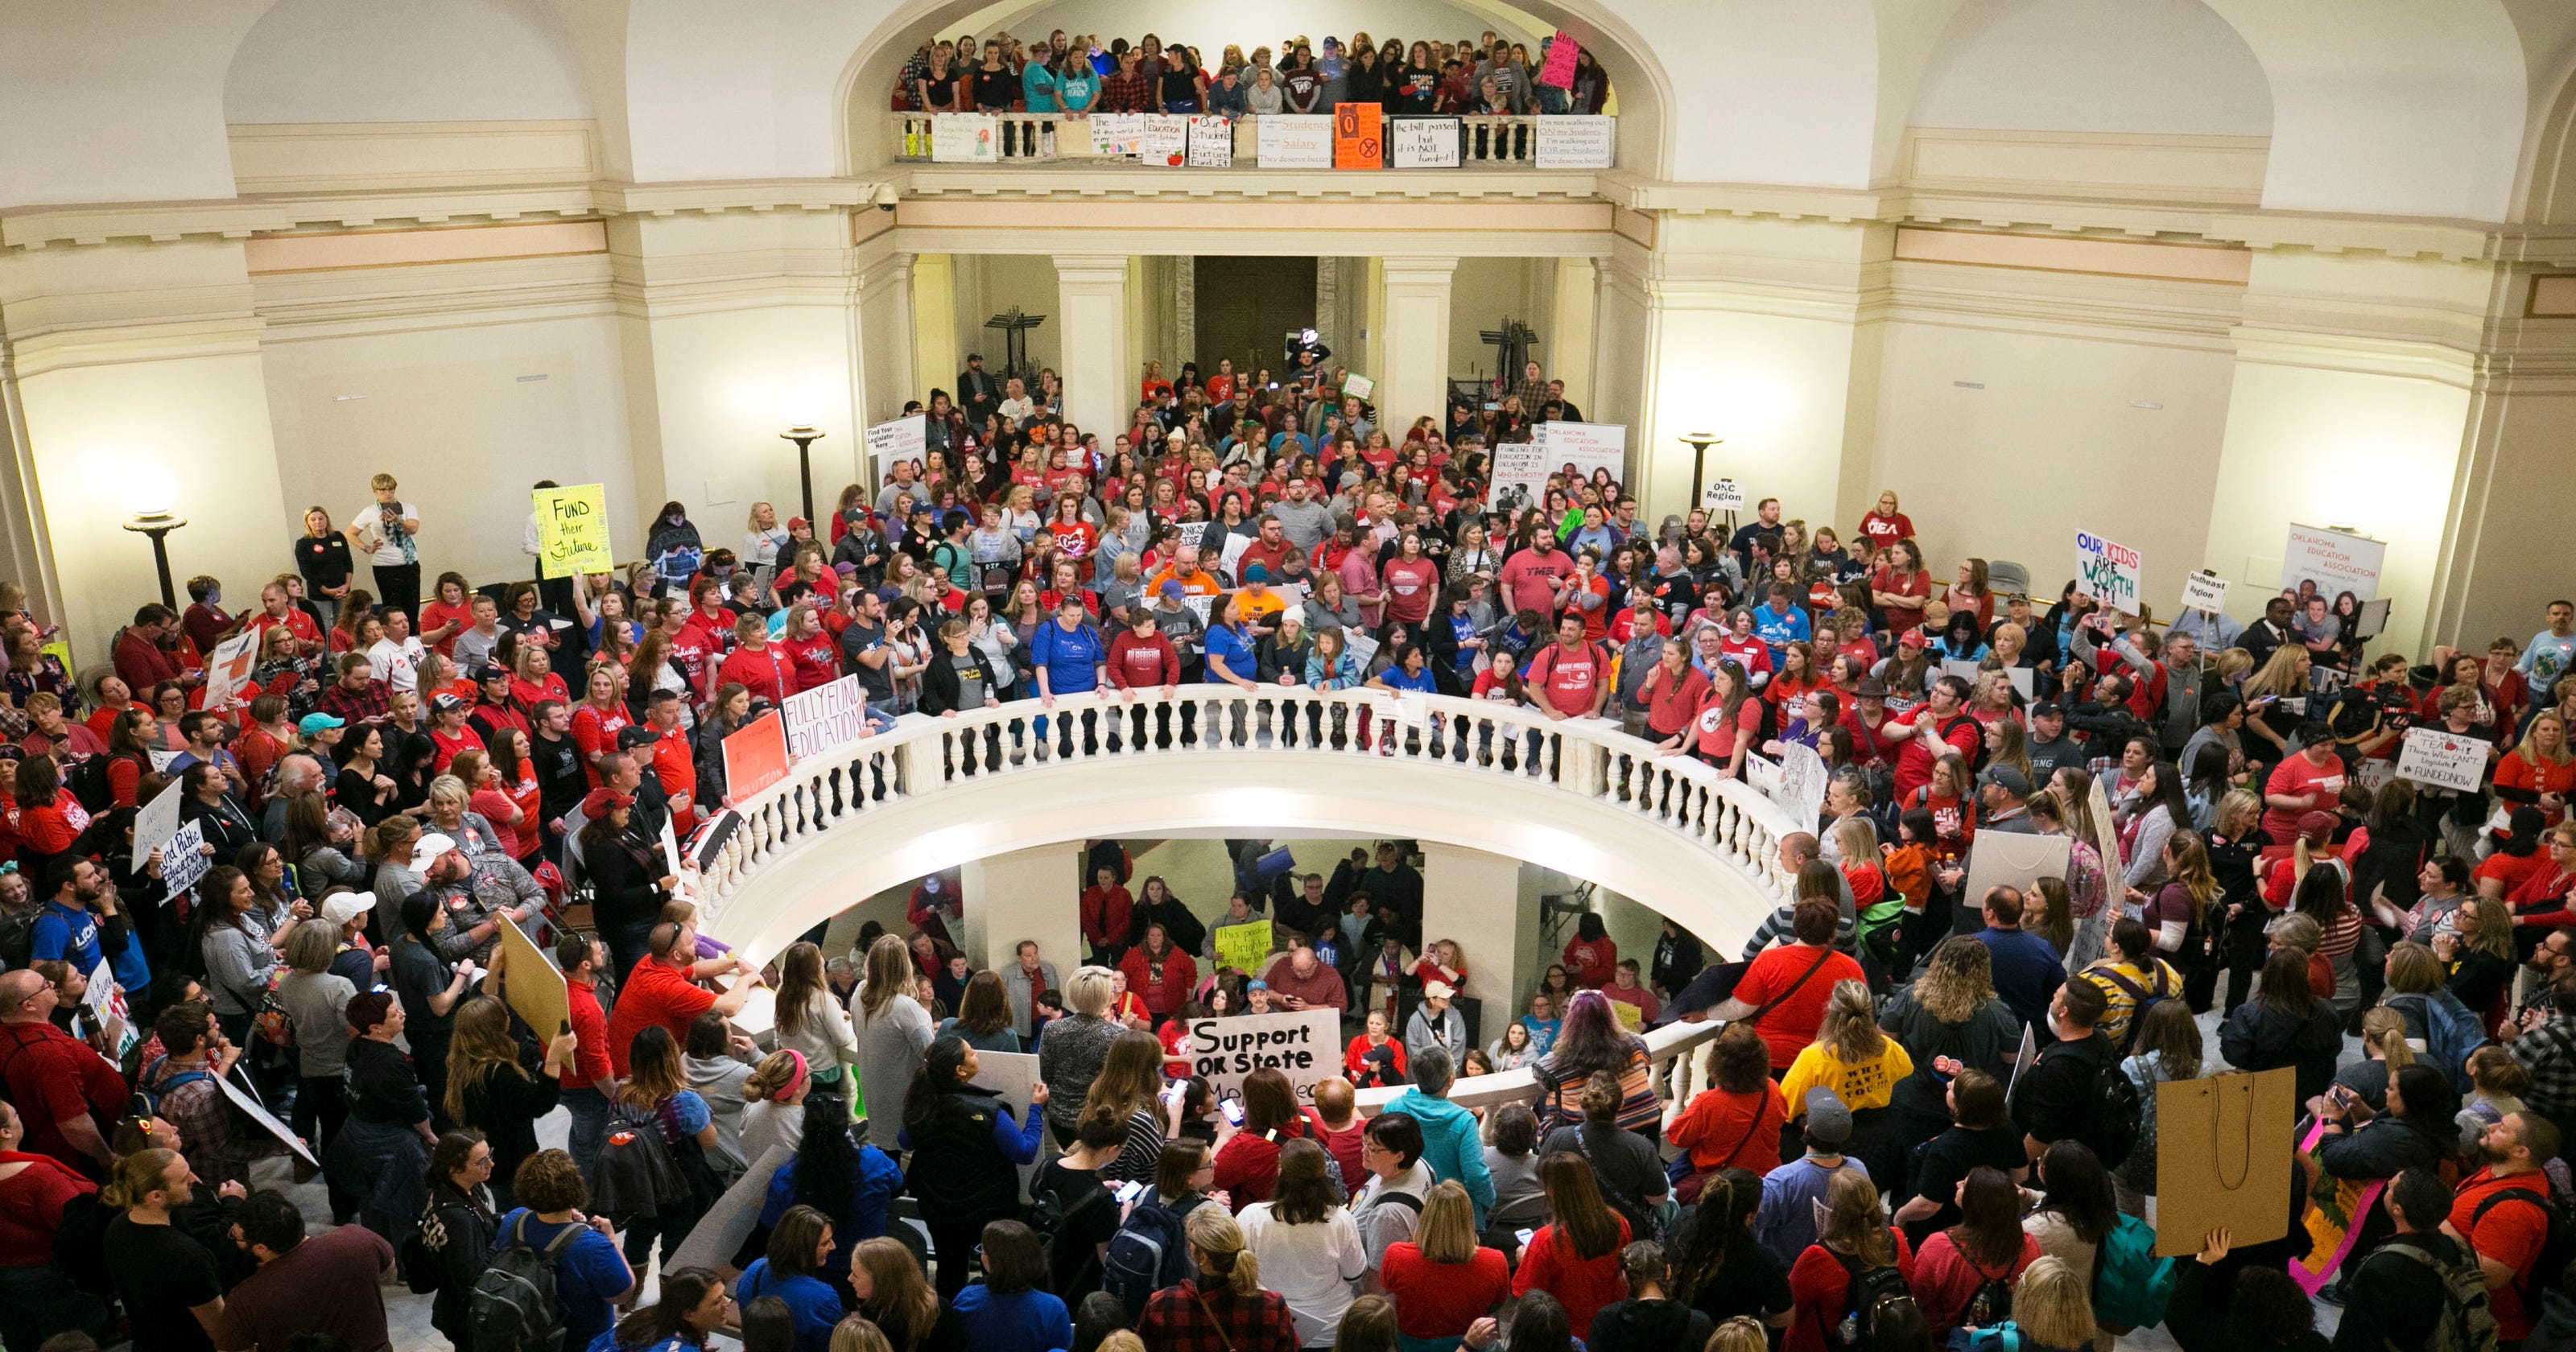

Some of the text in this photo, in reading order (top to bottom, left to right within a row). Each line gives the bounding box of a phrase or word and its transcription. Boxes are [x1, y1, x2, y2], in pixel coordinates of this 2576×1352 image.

[1092, 116, 1110, 126] The
[1200, 116, 1222, 128] Our
[1282, 118, 1330, 130] Students
[1396, 121, 1457, 133] the bill passed
[1566, 118, 1594, 127] walking
[1148, 125, 1181, 134] EDUCATION
[1191, 128, 1231, 139] Students
[1539, 128, 1555, 136] ON
[1282, 138, 1317, 149] Salary
[1418, 134, 1433, 143] but
[1560, 137, 1587, 146] walking
[1192, 149, 1229, 159] Future
[1397, 143, 1439, 153] it is NOT
[1191, 157, 1229, 167] Fund It
[1279, 155, 1306, 163] deserve
[1558, 157, 1583, 165] deserve
[868, 428, 881, 437] Find
[881, 427, 893, 435] Your
[1549, 428, 1585, 437] OKLAHOMA
[868, 433, 894, 444] Legislator
[1579, 446, 1620, 454] ASSOCIATION
[1714, 483, 1736, 492] OKC
[1707, 491, 1742, 501] Region
[552, 498, 590, 521] FUND
[561, 523, 584, 536] their
[1180, 526, 1203, 536] ANKS
[1868, 521, 1897, 535] OEA
[1183, 532, 1200, 542] ISE
[2291, 532, 2336, 549] OKLAHOMA
[550, 538, 599, 562] Future
[2078, 533, 2138, 569] OUR KIDS
[2307, 547, 2351, 562] EDUCATION
[985, 563, 999, 571] RIP
[2095, 554, 2117, 575] ARE
[2323, 561, 2376, 579] ASSOCIATION
[2083, 560, 2133, 599] WORTH
[2190, 572, 2225, 590] Southeast
[2093, 582, 2116, 604] IT!
[2190, 585, 2214, 600] Region
[786, 677, 861, 727] FULLY FUND
[789, 703, 865, 759] EDUCATION!
[2439, 732, 2455, 743] Who
[2408, 744, 2432, 755] Those
[2432, 748, 2451, 760] Who
[1748, 754, 1764, 773] MY
[2033, 759, 2054, 768] TING
[175, 829, 200, 855] Public
[161, 847, 202, 883] Education
[1220, 925, 1270, 942] This poster
[1232, 940, 1270, 954] brighter
[1194, 1020, 1311, 1054] Support
[1196, 1049, 1314, 1078] OK State
[1847, 1063, 1881, 1078] WHY
[1844, 1071, 1885, 1089] CAN'T
[1845, 1079, 1888, 1099] YOU!!!
